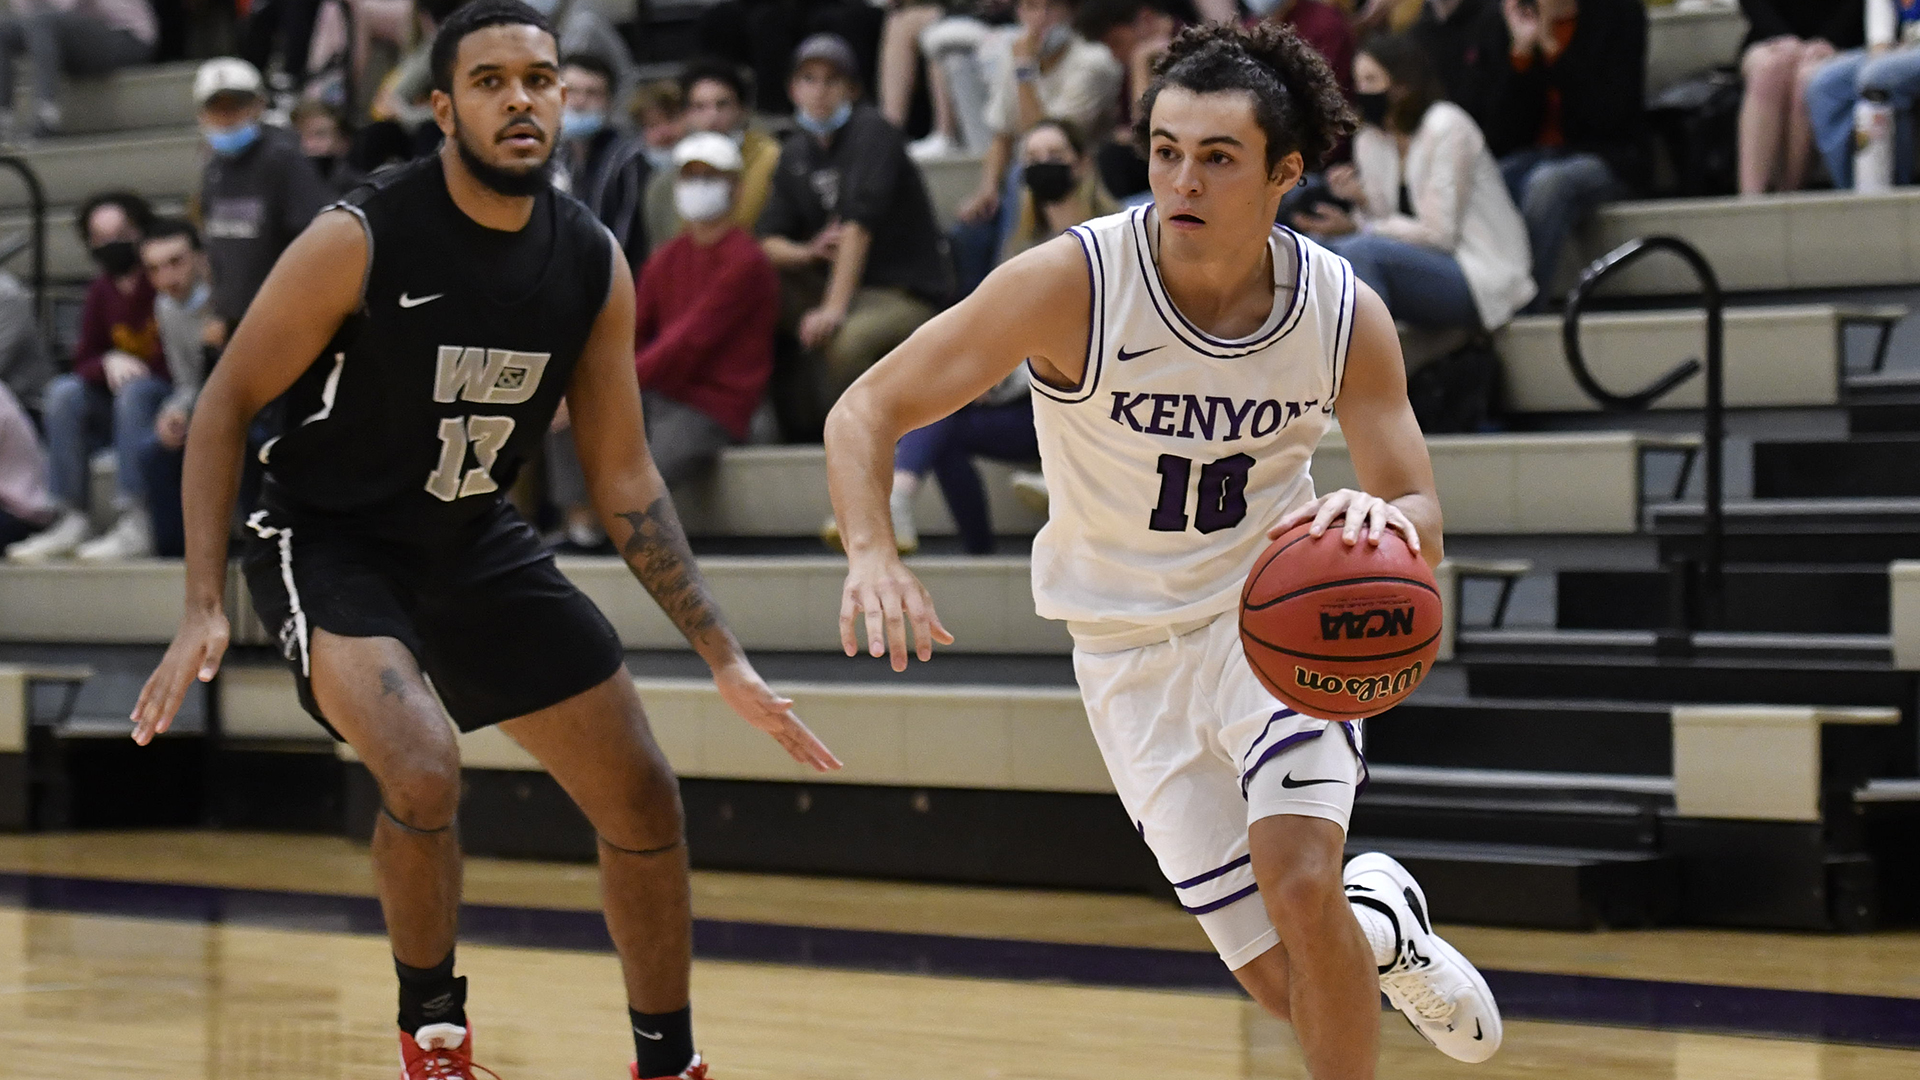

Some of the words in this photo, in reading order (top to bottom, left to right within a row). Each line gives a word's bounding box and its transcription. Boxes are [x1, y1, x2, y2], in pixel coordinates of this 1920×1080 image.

[424, 414, 516, 502] 13
[1148, 452, 1257, 535] 10
[1319, 606, 1415, 641] NCAA
[1294, 660, 1423, 703] Wilson
